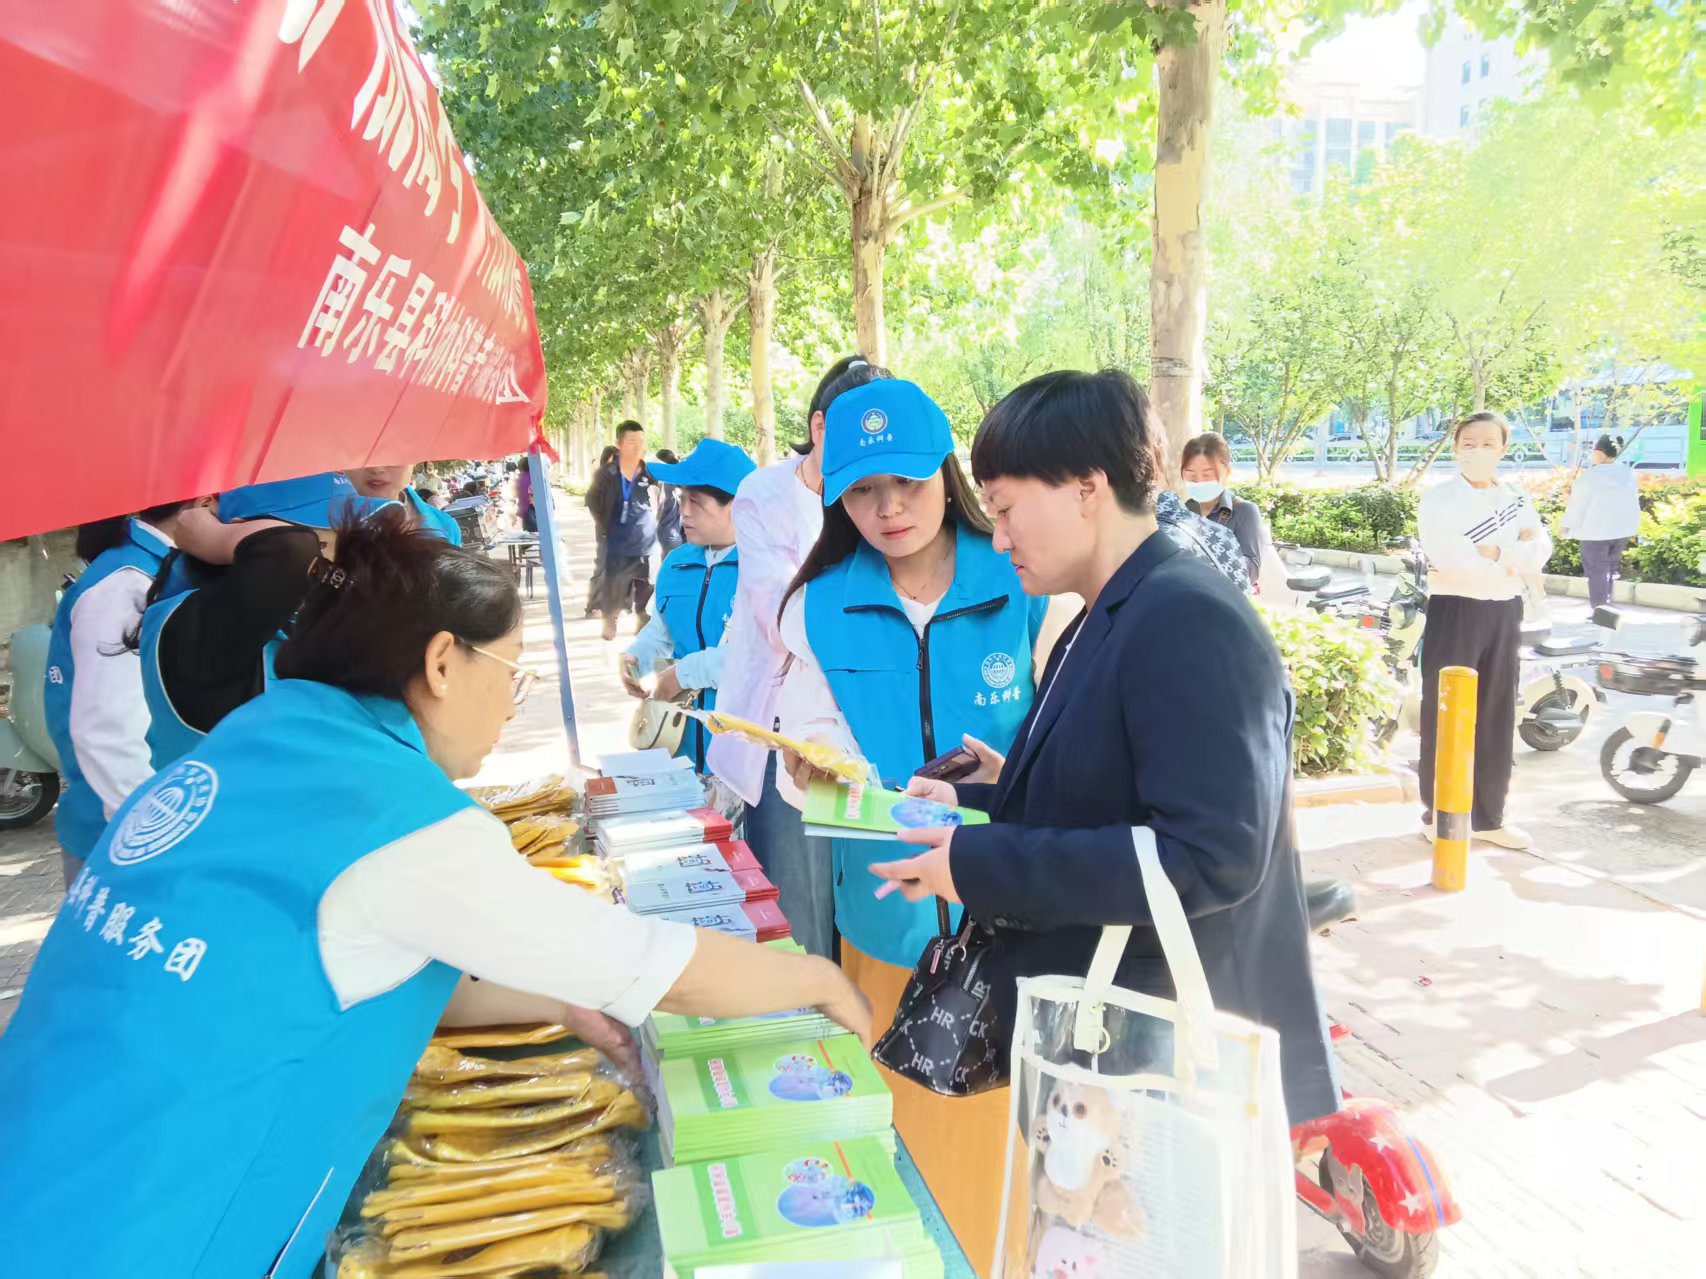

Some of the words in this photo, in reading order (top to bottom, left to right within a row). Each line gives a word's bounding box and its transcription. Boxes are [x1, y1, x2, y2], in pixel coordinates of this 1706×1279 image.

[930, 1006, 955, 1030] HR
[969, 1020, 989, 1038] CK
[911, 1052, 935, 1076] HR
